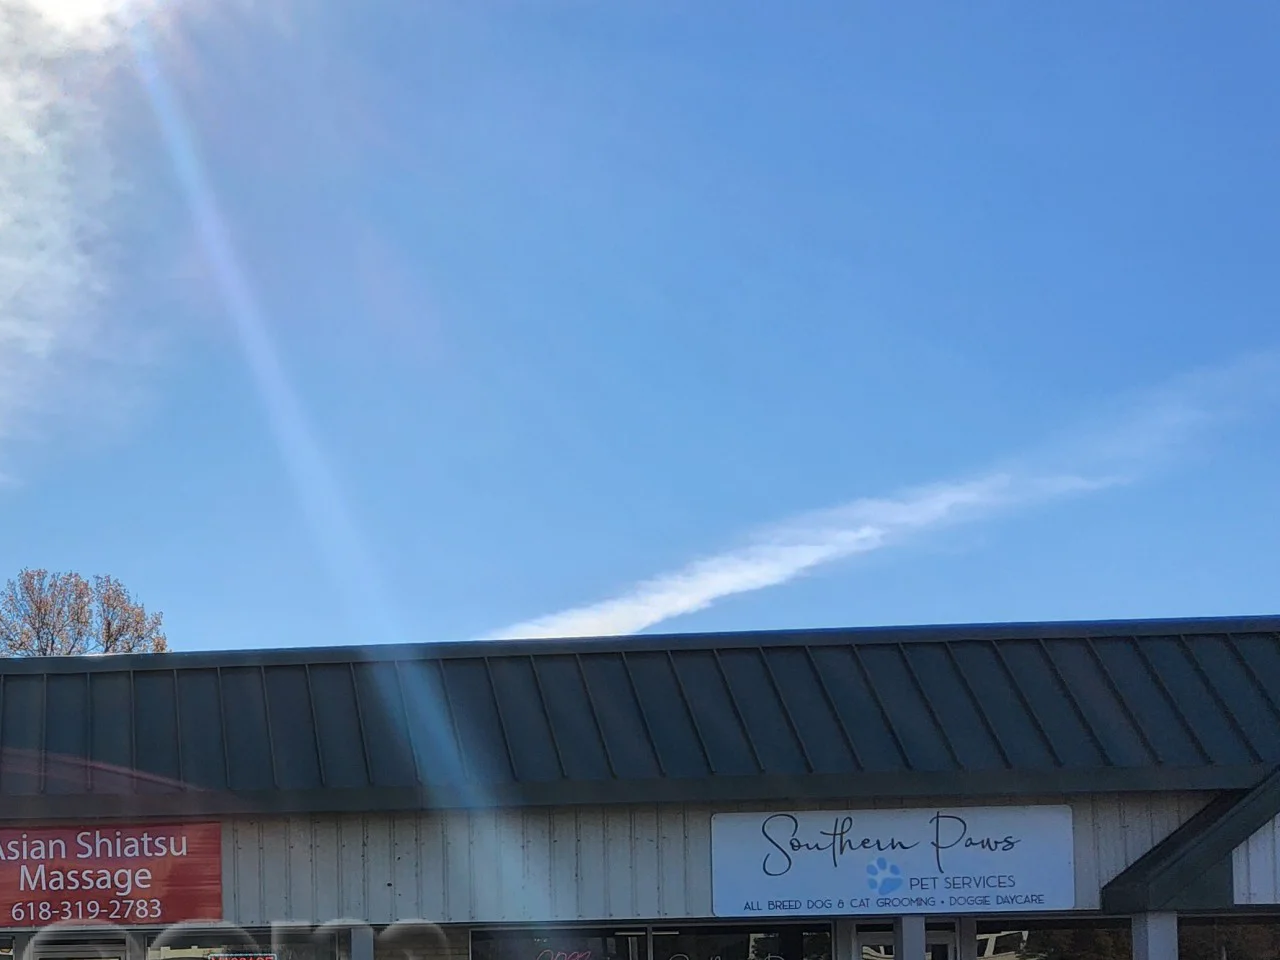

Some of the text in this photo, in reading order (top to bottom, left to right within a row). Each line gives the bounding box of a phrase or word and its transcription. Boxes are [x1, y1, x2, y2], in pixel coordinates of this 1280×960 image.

[76, 831, 188, 859] Shiatsu
[761, 811, 1021, 876] Southern Paws
[19, 865, 153, 897] Massage
[909, 875, 1016, 890] PET SERVICES
[11, 899, 162, 921] 618-319-2783
[743, 900, 763, 911] ALL
[767, 900, 802, 910] BREED
[806, 899, 832, 909] DOG
[850, 898, 871, 908] CAT
[876, 897, 936, 908] GROOMING
[949, 895, 991, 907] DOGGIE
[995, 894, 1045, 905] DAYCARE
